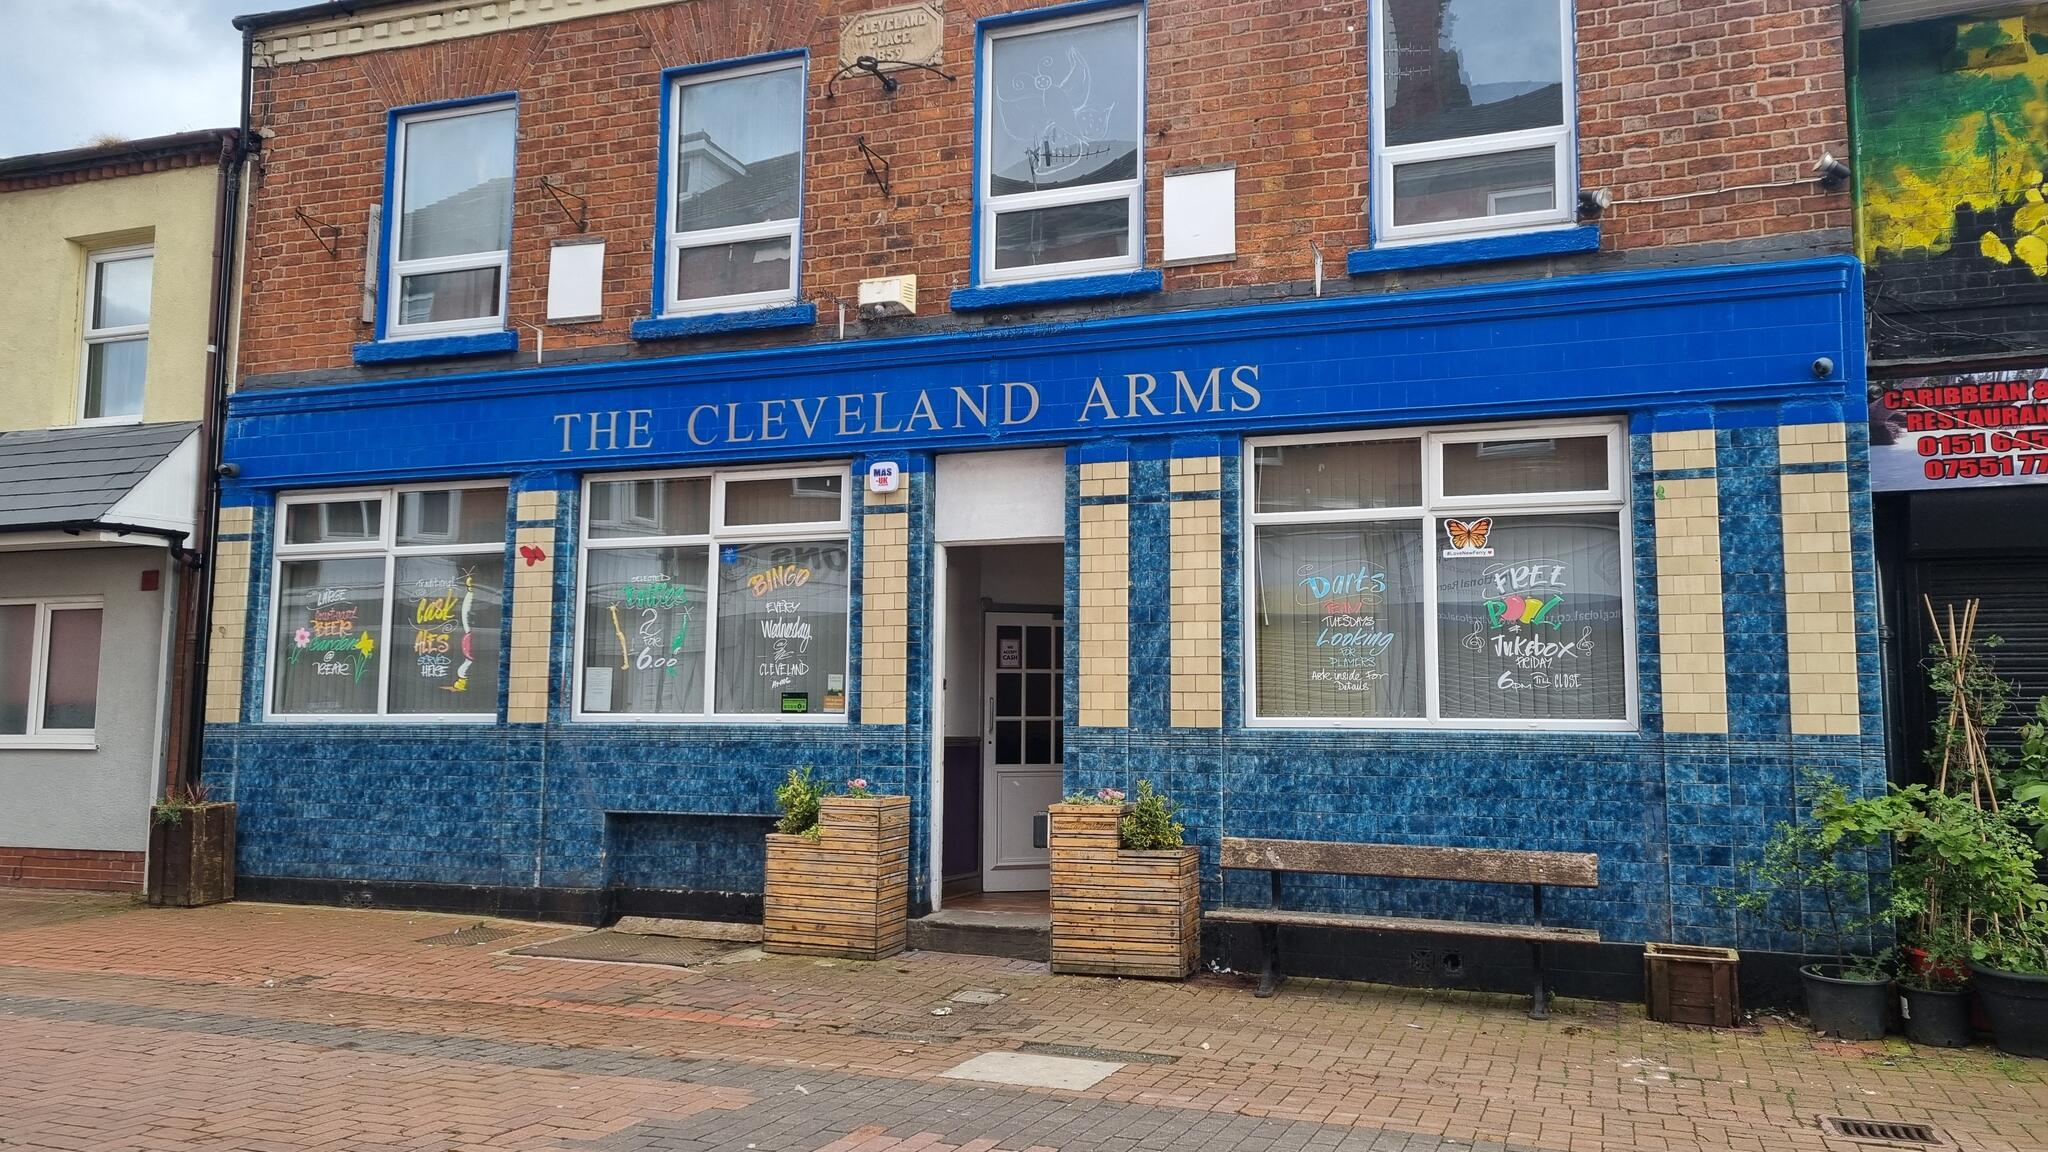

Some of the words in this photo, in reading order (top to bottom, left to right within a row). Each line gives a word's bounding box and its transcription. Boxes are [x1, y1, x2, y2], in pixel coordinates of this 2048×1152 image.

[855, 14, 929, 37] CLEVELAND
[871, 32, 912, 48] PLACE
[1883, 381, 2028, 409] CARIBBEAN
[554, 409, 653, 452] THE
[687, 382, 1040, 445] CLEVELAND
[1077, 365, 1261, 422] ARMS
[1918, 433, 1986, 456] 0151
[873, 468, 892, 477] MAS
[1925, 456, 2014, 480] 07551
[747, 564, 811, 597] BINGO
[1298, 566, 1386, 599] Darts
[1493, 564, 1567, 594] FREE
[317, 588, 348, 606] LARGE
[765, 599, 801, 613] EVERY
[310, 619, 353, 637] BEER
[639, 608, 662, 636] 2
[1315, 626, 1395, 656] Looking
[312, 661, 353, 676] REAR
[636, 646, 678, 670] 6.00
[759, 659, 810, 676] CLEVELAND
[1515, 656, 1553, 669] FRIDAY
